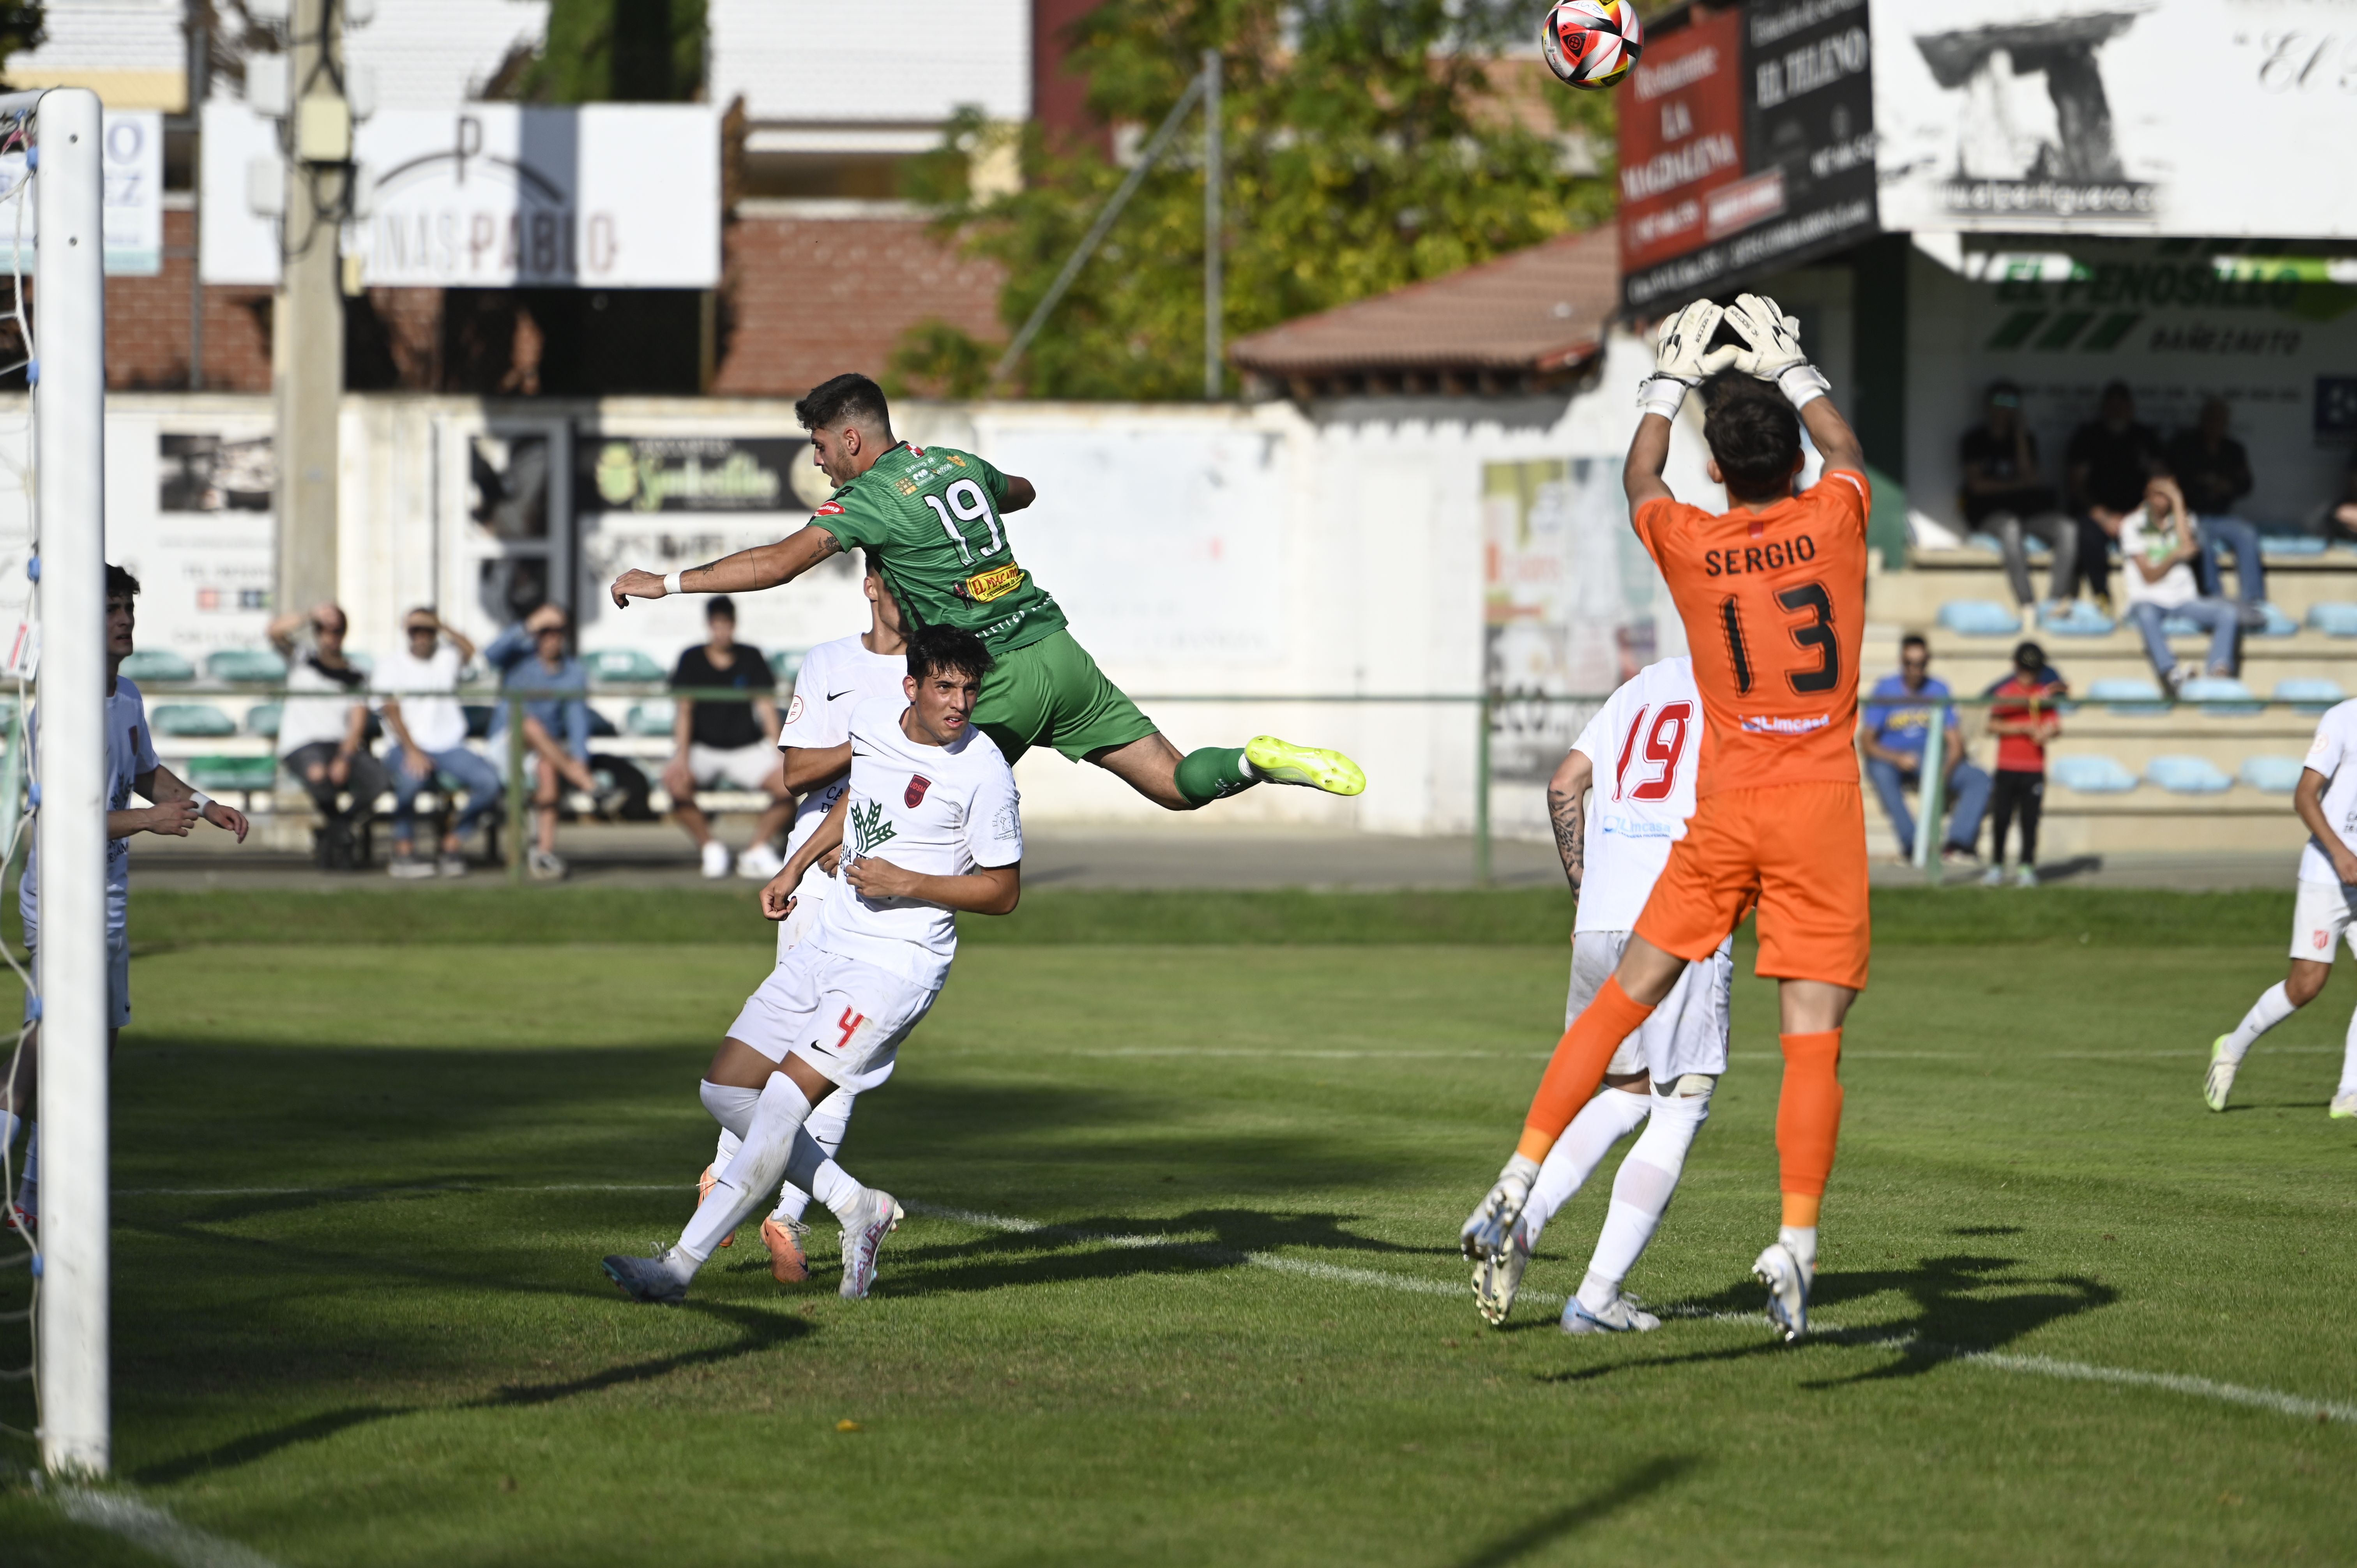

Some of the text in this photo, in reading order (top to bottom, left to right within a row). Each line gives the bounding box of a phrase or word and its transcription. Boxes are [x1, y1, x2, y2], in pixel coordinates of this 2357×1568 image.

[922, 477, 1003, 568] 19
[1705, 534, 1815, 577] SERGIO
[983, 583, 1010, 598] Legumbres
[1719, 579, 1842, 698] 13
[1611, 700, 1694, 803] 19
[909, 781, 926, 793] UDSM
[835, 1004, 865, 1049] 4
